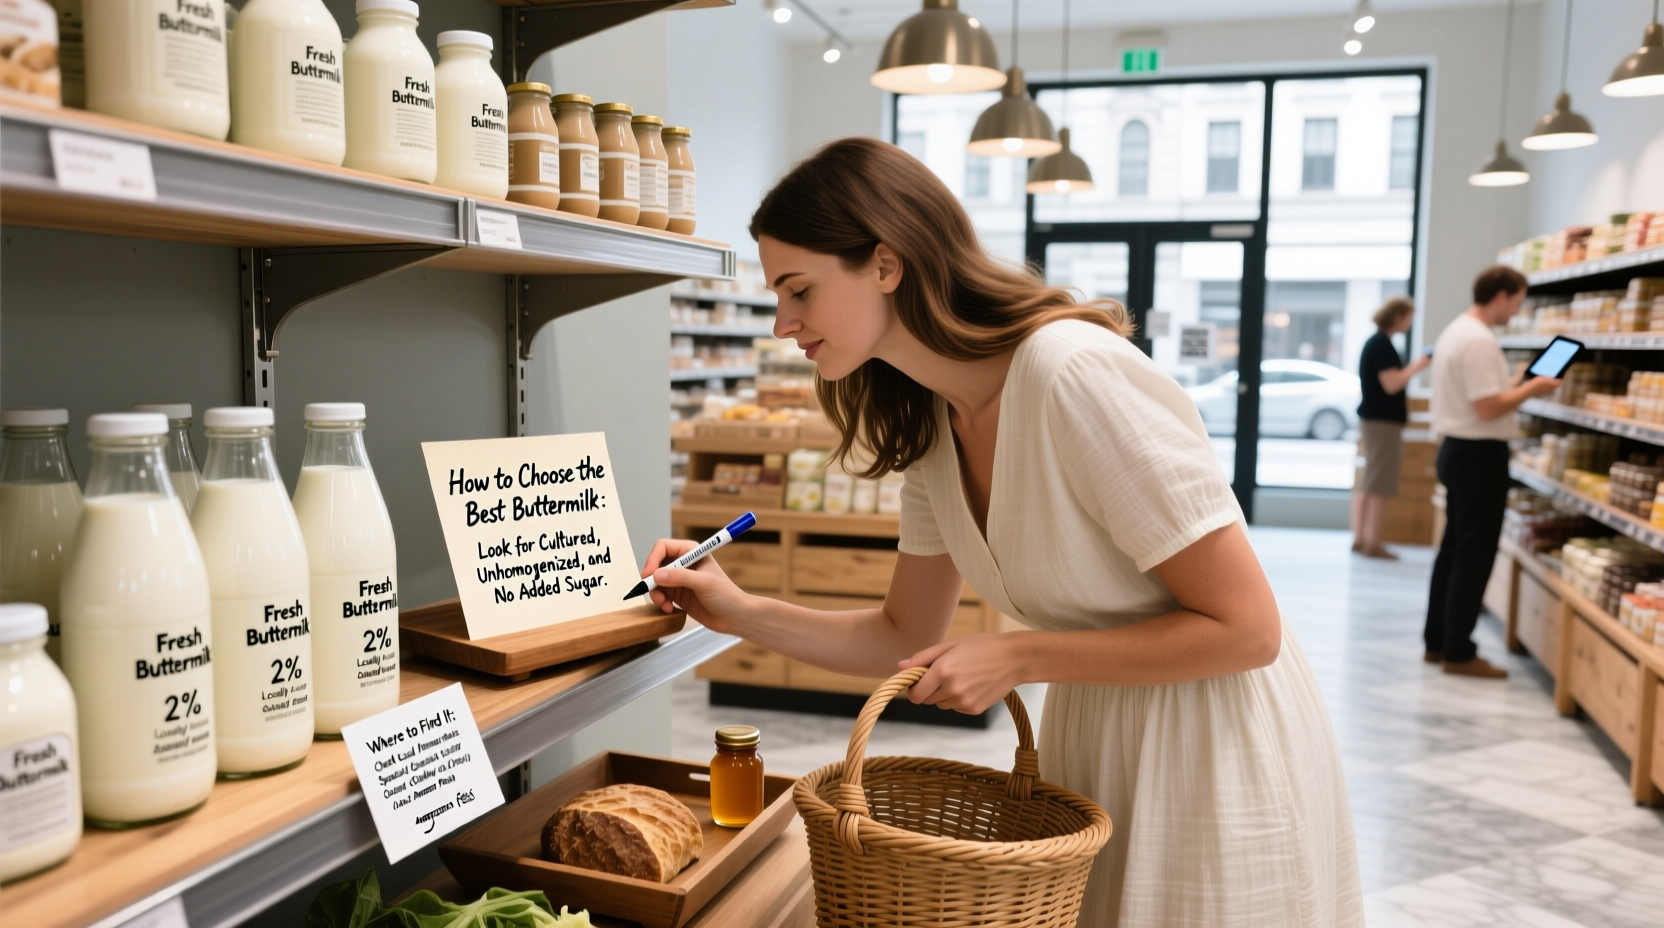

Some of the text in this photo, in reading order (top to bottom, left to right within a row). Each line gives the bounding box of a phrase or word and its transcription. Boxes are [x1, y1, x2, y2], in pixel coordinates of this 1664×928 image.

[449, 455, 605, 495] How to Choose the
[465, 487, 606, 527] Best Buttermilk:
[478, 526, 601, 560] Look for Cultured,
[477, 546, 612, 584] Unhomogenized, and
[359, 575, 393, 597] Fresh
[494, 573, 608, 604] No Added Sugar.
[264, 598, 303, 623] Fresh
[157, 625, 202, 653] Fresh
[363, 626, 392, 653] 2%
[271, 655, 303, 685] 2%
[164, 689, 201, 722] 2%
[366, 732, 404, 754] Where
[406, 726, 418, 738] to
